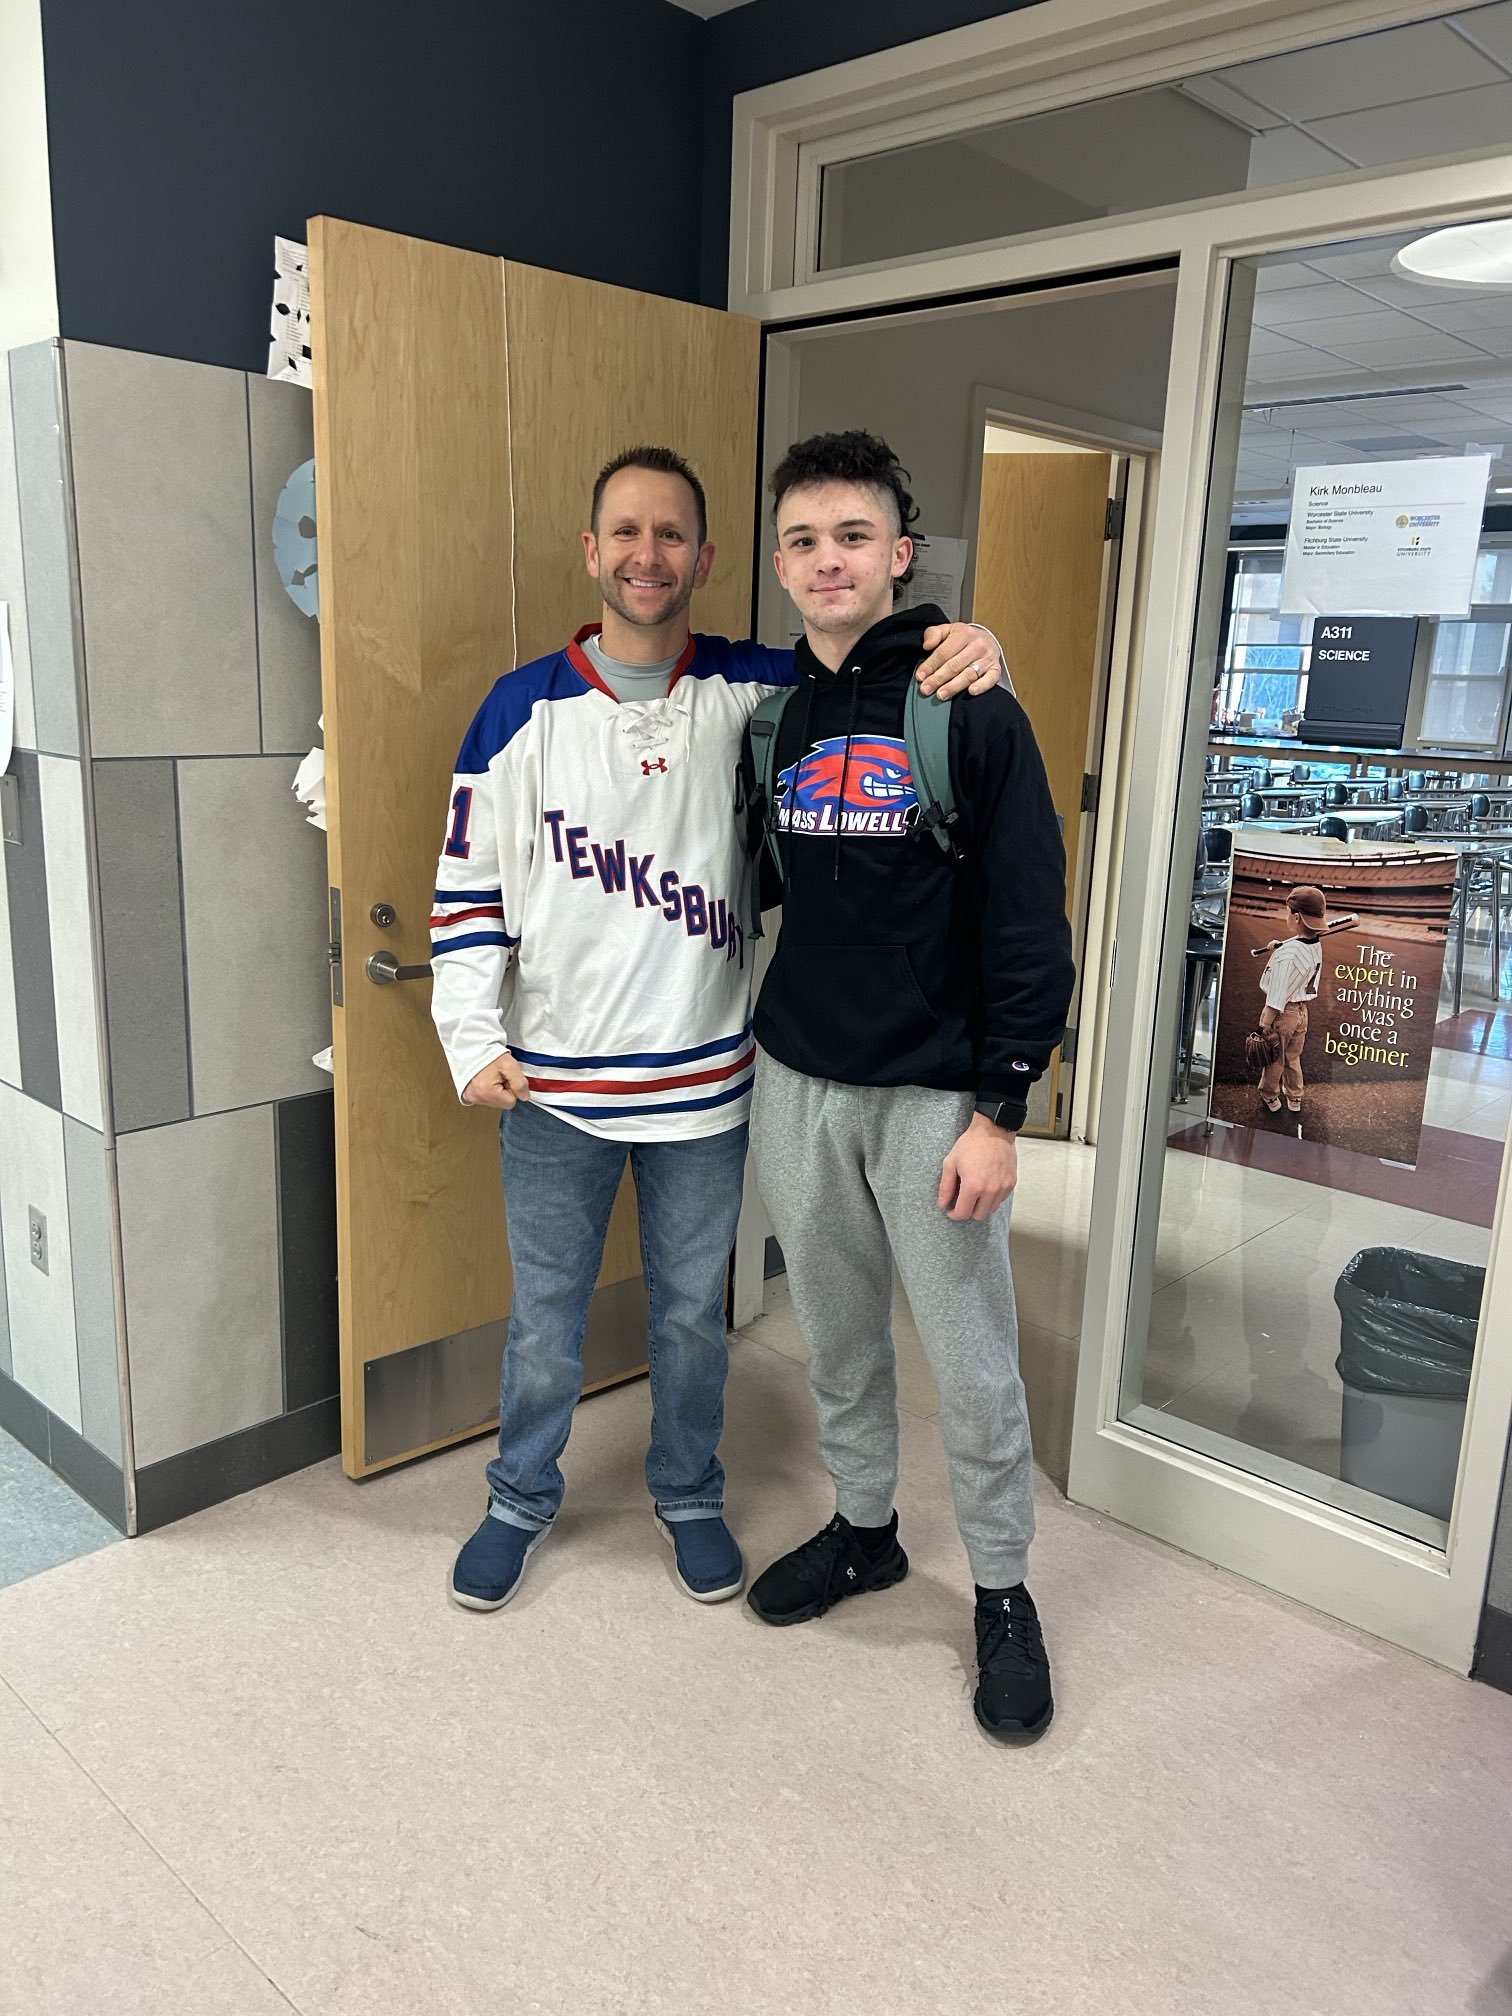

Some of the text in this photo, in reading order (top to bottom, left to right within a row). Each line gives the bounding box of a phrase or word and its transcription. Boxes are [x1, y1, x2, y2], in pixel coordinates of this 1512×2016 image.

[1309, 484, 1382, 496] Kirk Monbleau
[1321, 626, 1352, 639] A311
[1318, 650, 1370, 661] SCIENCE
[1357, 945, 1392, 968] The
[1335, 964, 1417, 990] expert in
[1337, 987, 1414, 1019] anything
[1361, 1008, 1395, 1027] was
[1339, 1022, 1398, 1045] once a
[1325, 1032, 1409, 1068] beginner.
